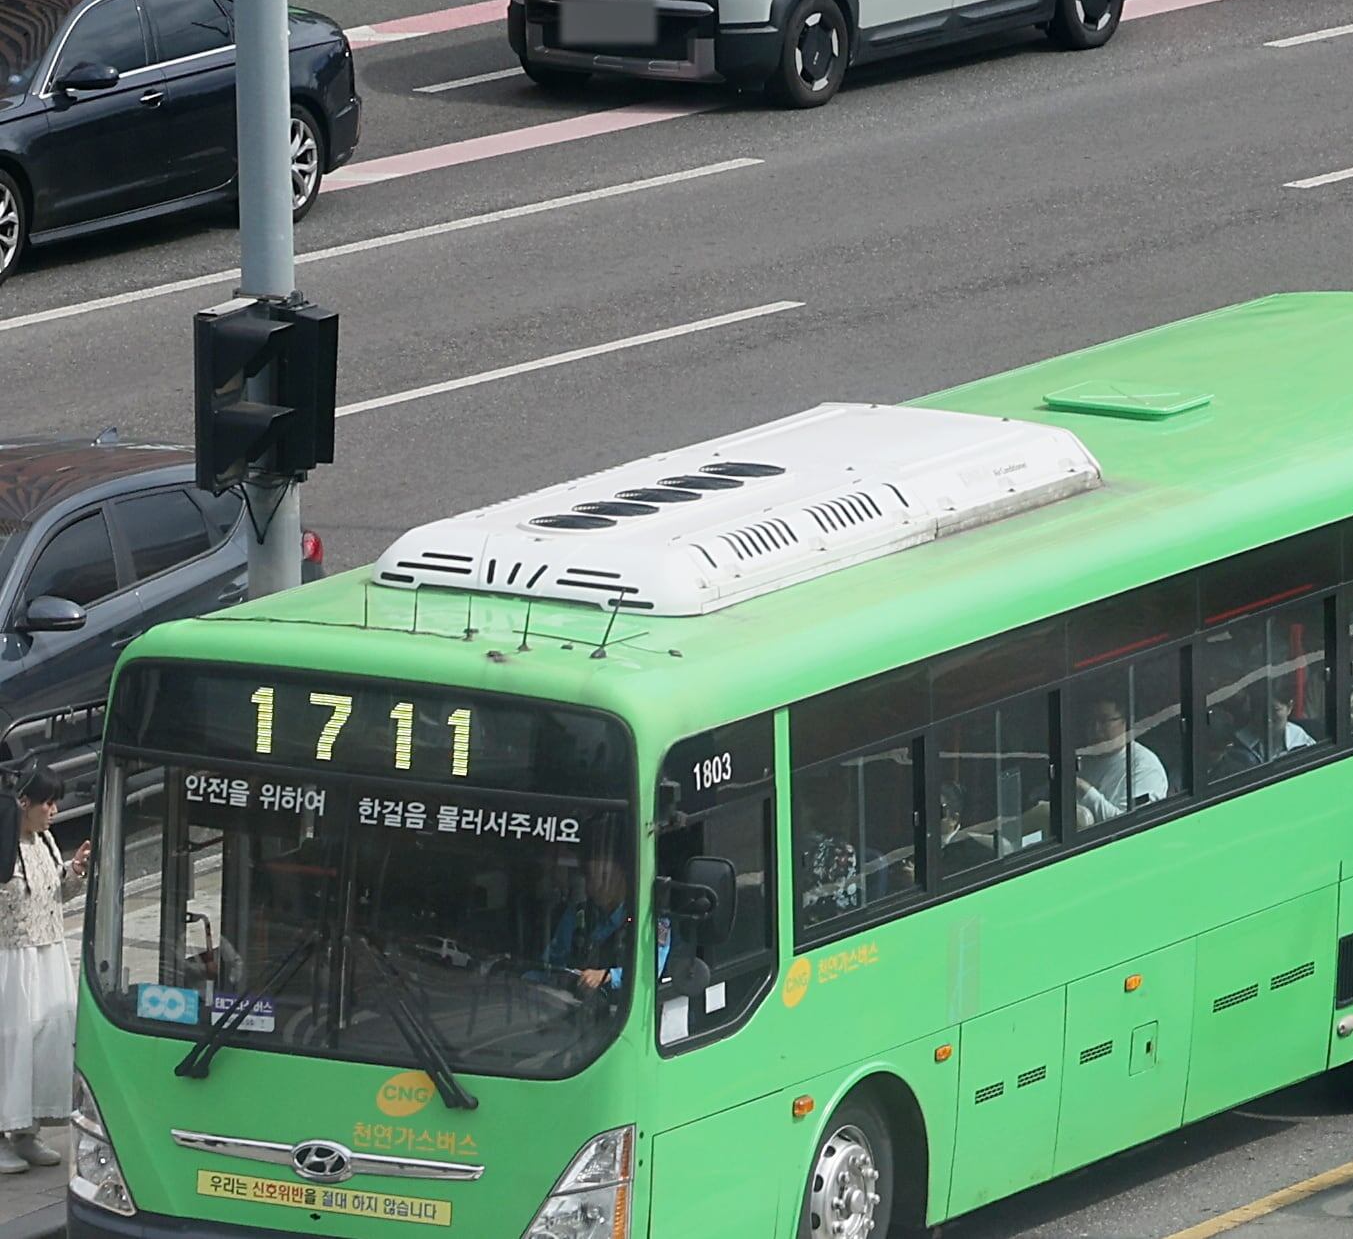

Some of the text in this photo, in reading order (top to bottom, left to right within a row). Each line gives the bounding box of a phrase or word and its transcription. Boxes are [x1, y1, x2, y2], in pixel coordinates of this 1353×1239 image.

[250, 686, 472, 777] 1711
[692, 752, 733, 792] 1803
[184, 774, 582, 845] 안전을 위하여 한걸음 물러서주세요
[381, 1084, 431, 1104] CNG
[352, 1121, 479, 1157] 천연가스버스
[209, 1175, 438, 1221] 우리는 신호위반을 절대 하지 않습니다
